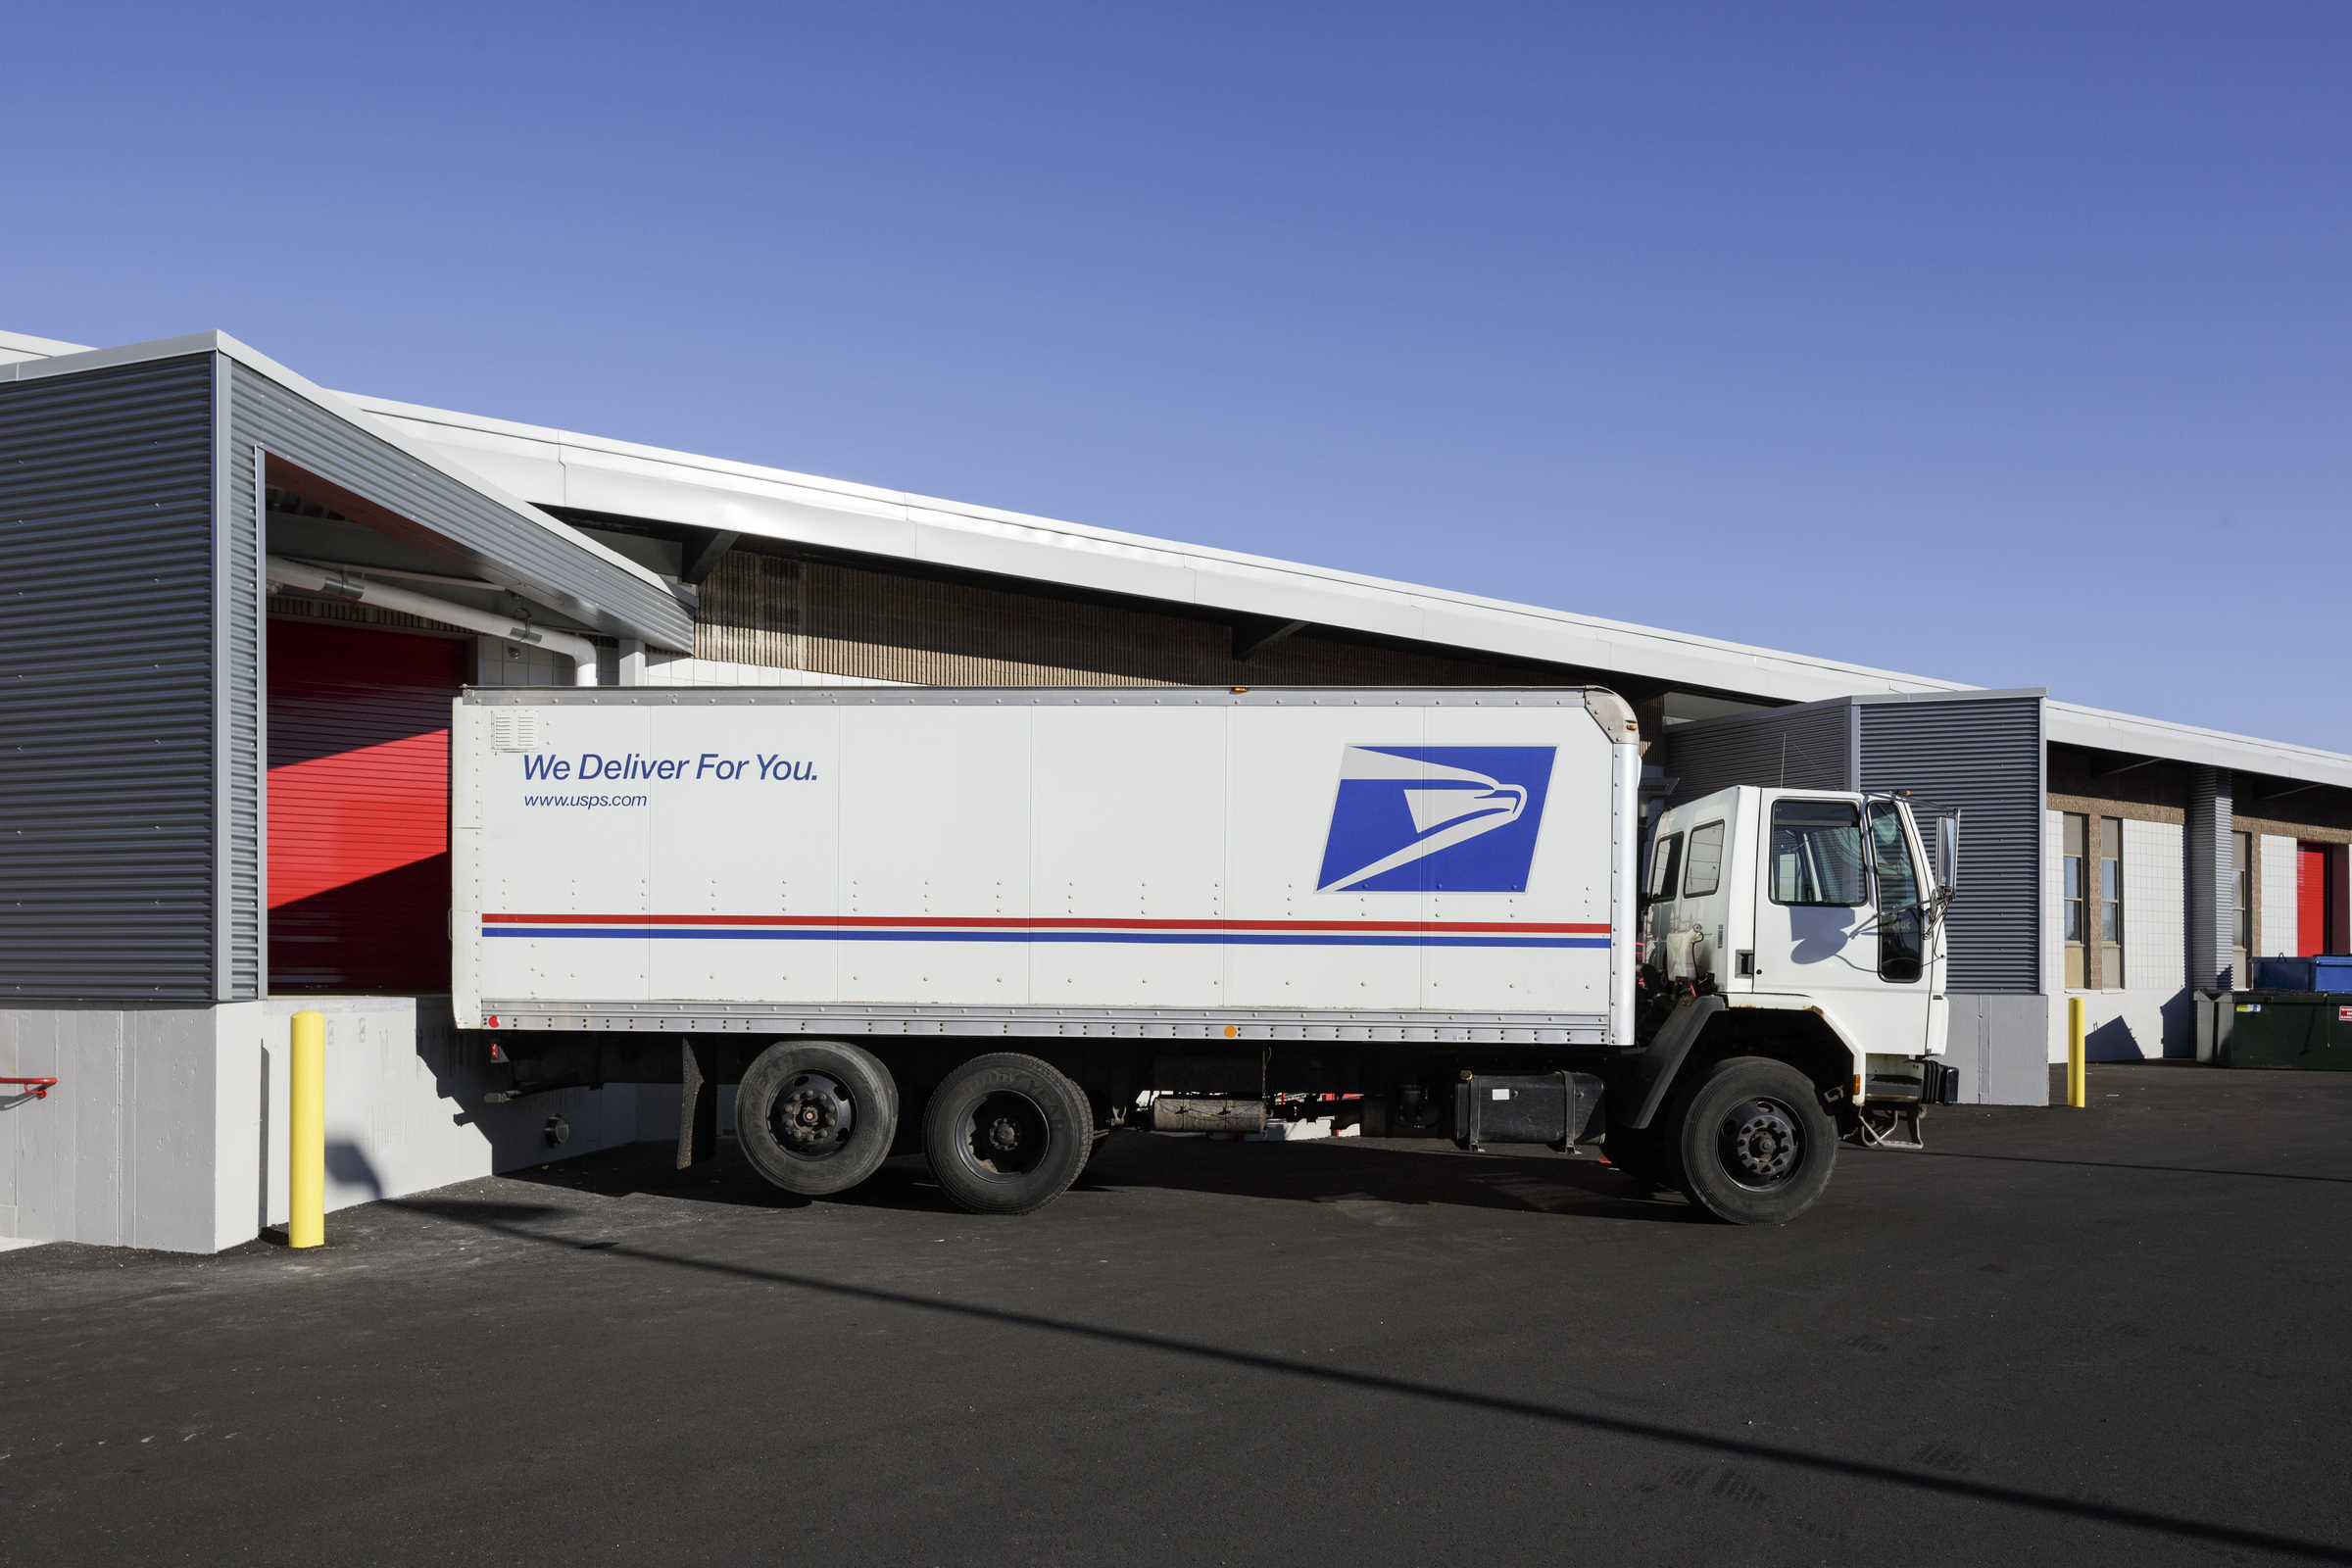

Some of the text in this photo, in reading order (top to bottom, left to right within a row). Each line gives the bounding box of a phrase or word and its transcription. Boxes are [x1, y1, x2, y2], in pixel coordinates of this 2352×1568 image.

[523, 753, 818, 781] We Deliver For You.
[523, 794, 648, 809] www.usps.com
